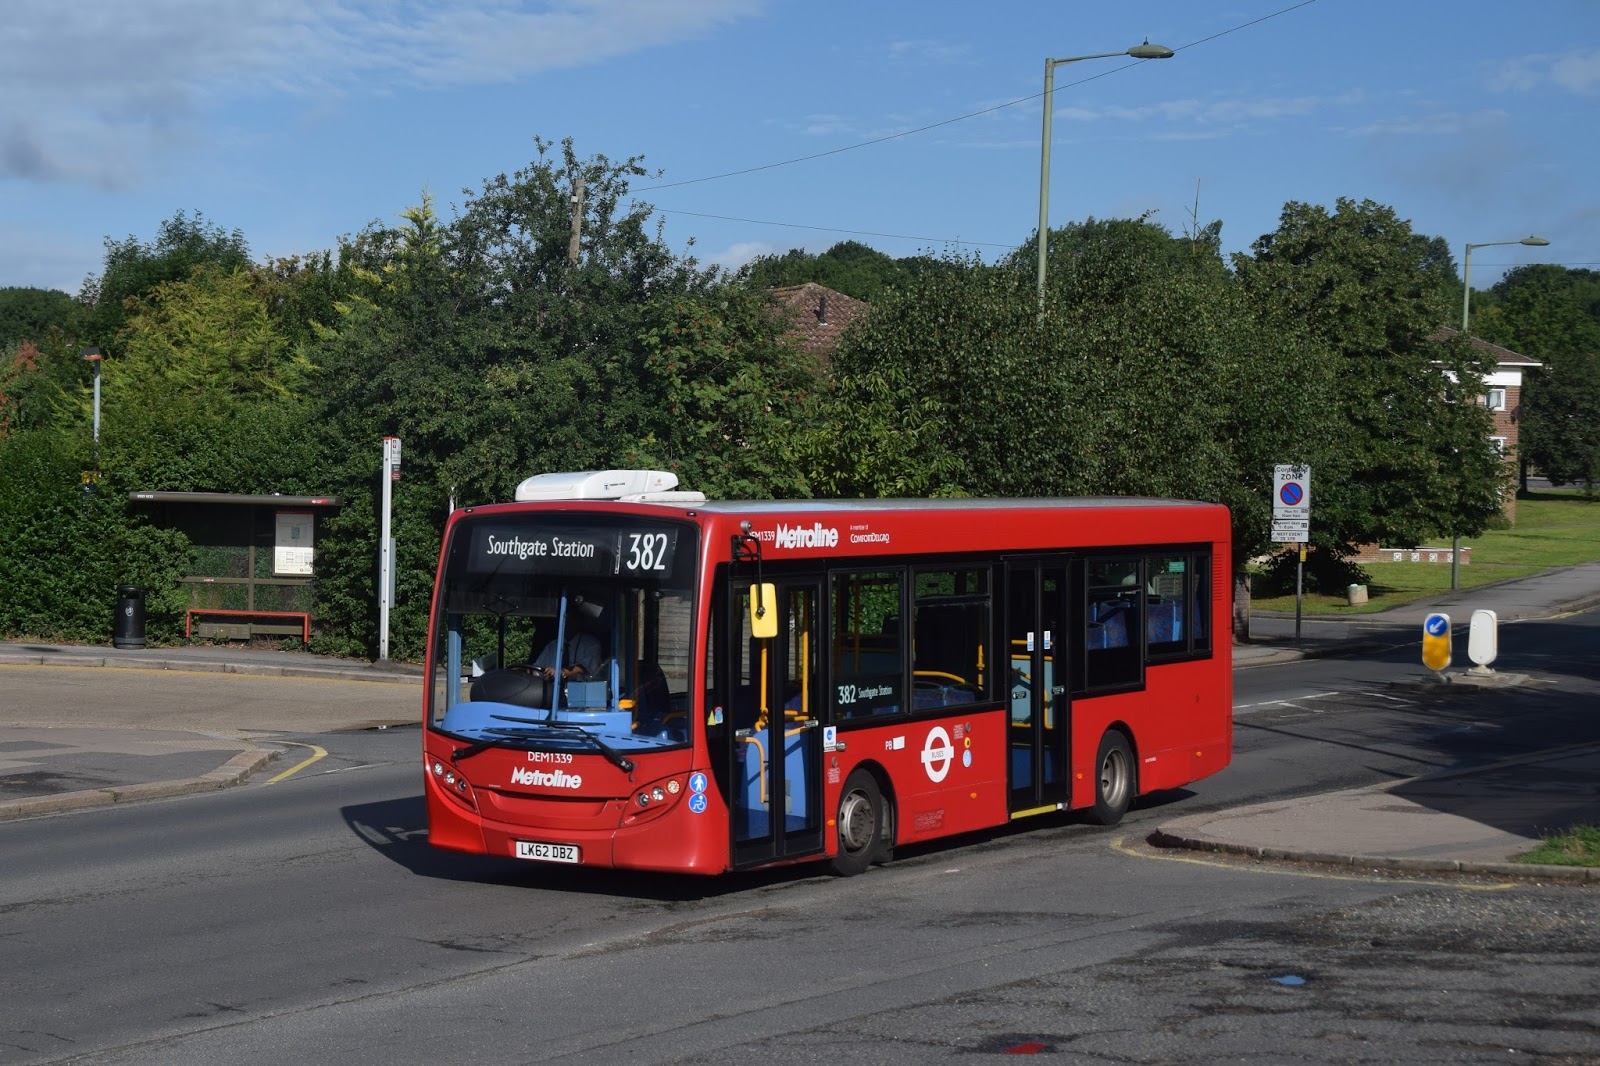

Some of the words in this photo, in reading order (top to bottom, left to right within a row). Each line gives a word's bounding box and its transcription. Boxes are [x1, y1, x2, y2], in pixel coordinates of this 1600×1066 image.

[775, 522, 839, 549] Metroline
[487, 534, 547, 560] Southgate
[551, 536, 594, 558] Station
[626, 533, 668, 571] 382
[838, 684, 857, 705] 382
[858, 687, 878, 699] Southgate
[878, 685, 893, 696] Station
[885, 740, 892, 750] PB
[931, 750, 944, 759] BUSES
[527, 751, 573, 764] DEM1339
[511, 766, 582, 789] Metroline
[521, 844, 549, 858] LK62
[552, 846, 573, 860] DBZ
